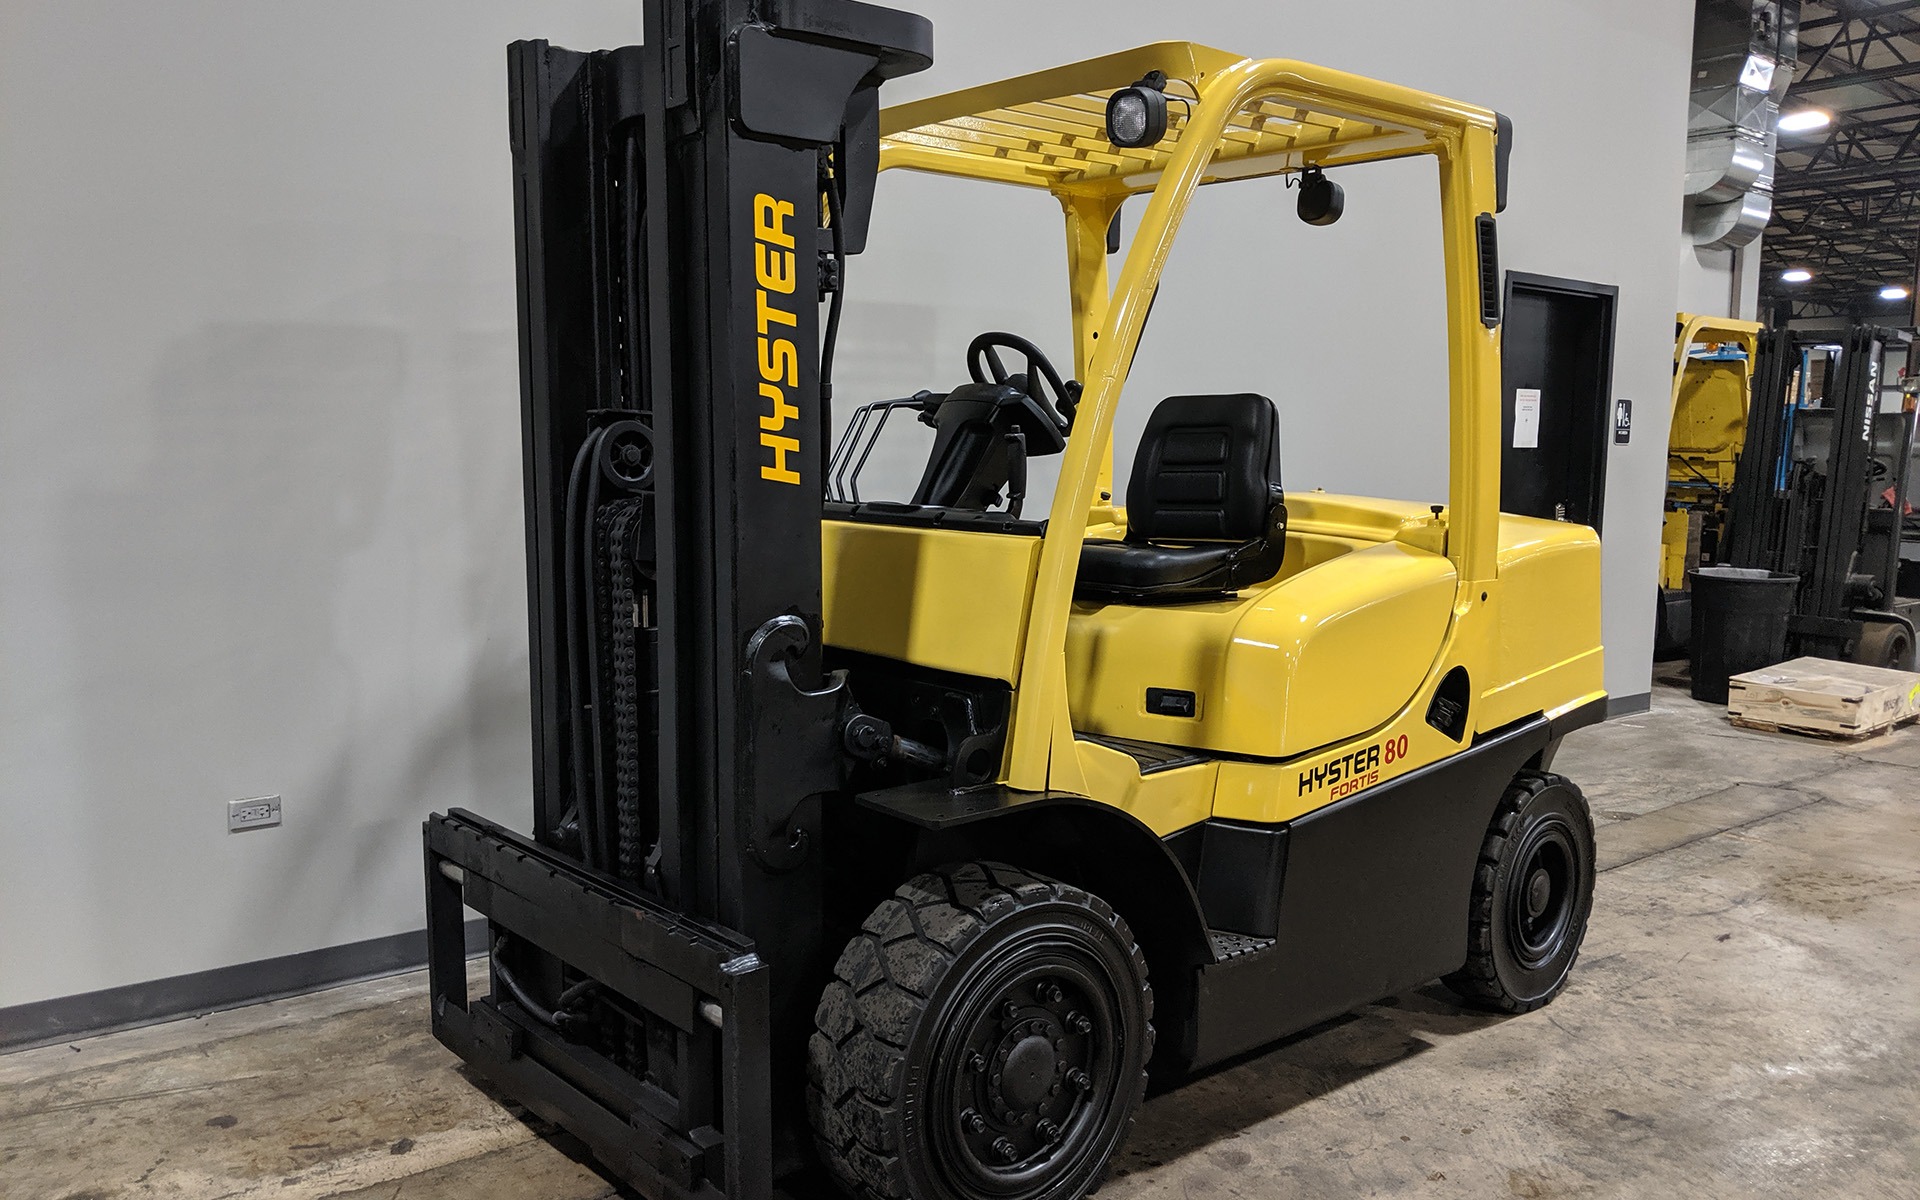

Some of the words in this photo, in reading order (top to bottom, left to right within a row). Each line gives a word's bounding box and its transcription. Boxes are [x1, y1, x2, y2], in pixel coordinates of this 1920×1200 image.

[754, 193, 801, 485] HYSTER
[1862, 361, 1878, 441] NISSAN
[1298, 744, 1380, 797] HYSTER
[1384, 734, 1408, 765] 80
[1330, 769, 1379, 801] FORTIS
